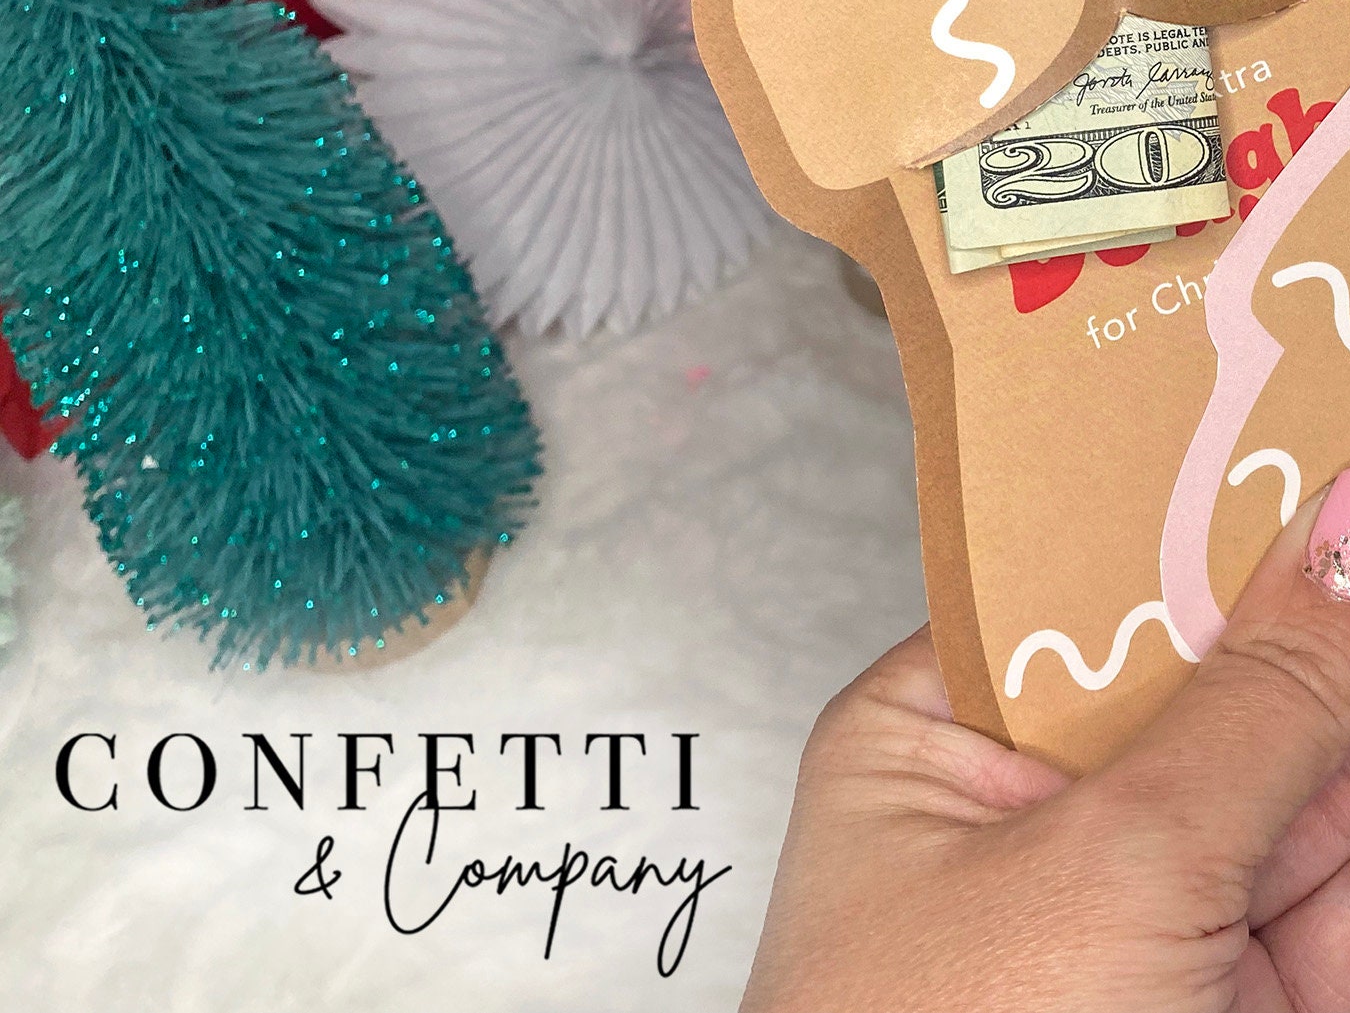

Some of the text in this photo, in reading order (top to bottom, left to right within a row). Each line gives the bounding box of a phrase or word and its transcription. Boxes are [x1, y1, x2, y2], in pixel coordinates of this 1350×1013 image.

[1106, 25, 1207, 46] OTE IS LEGAL TE
[1145, 39, 1189, 53] PUBLIC
[1211, 59, 1272, 98] tra
[1090, 102, 1137, 116] Treasurer
[1139, 97, 1149, 112] of
[1150, 95, 1165, 109] the
[1168, 91, 1198, 107] United
[978, 125, 1213, 209] 20
[1086, 307, 1138, 350] for
